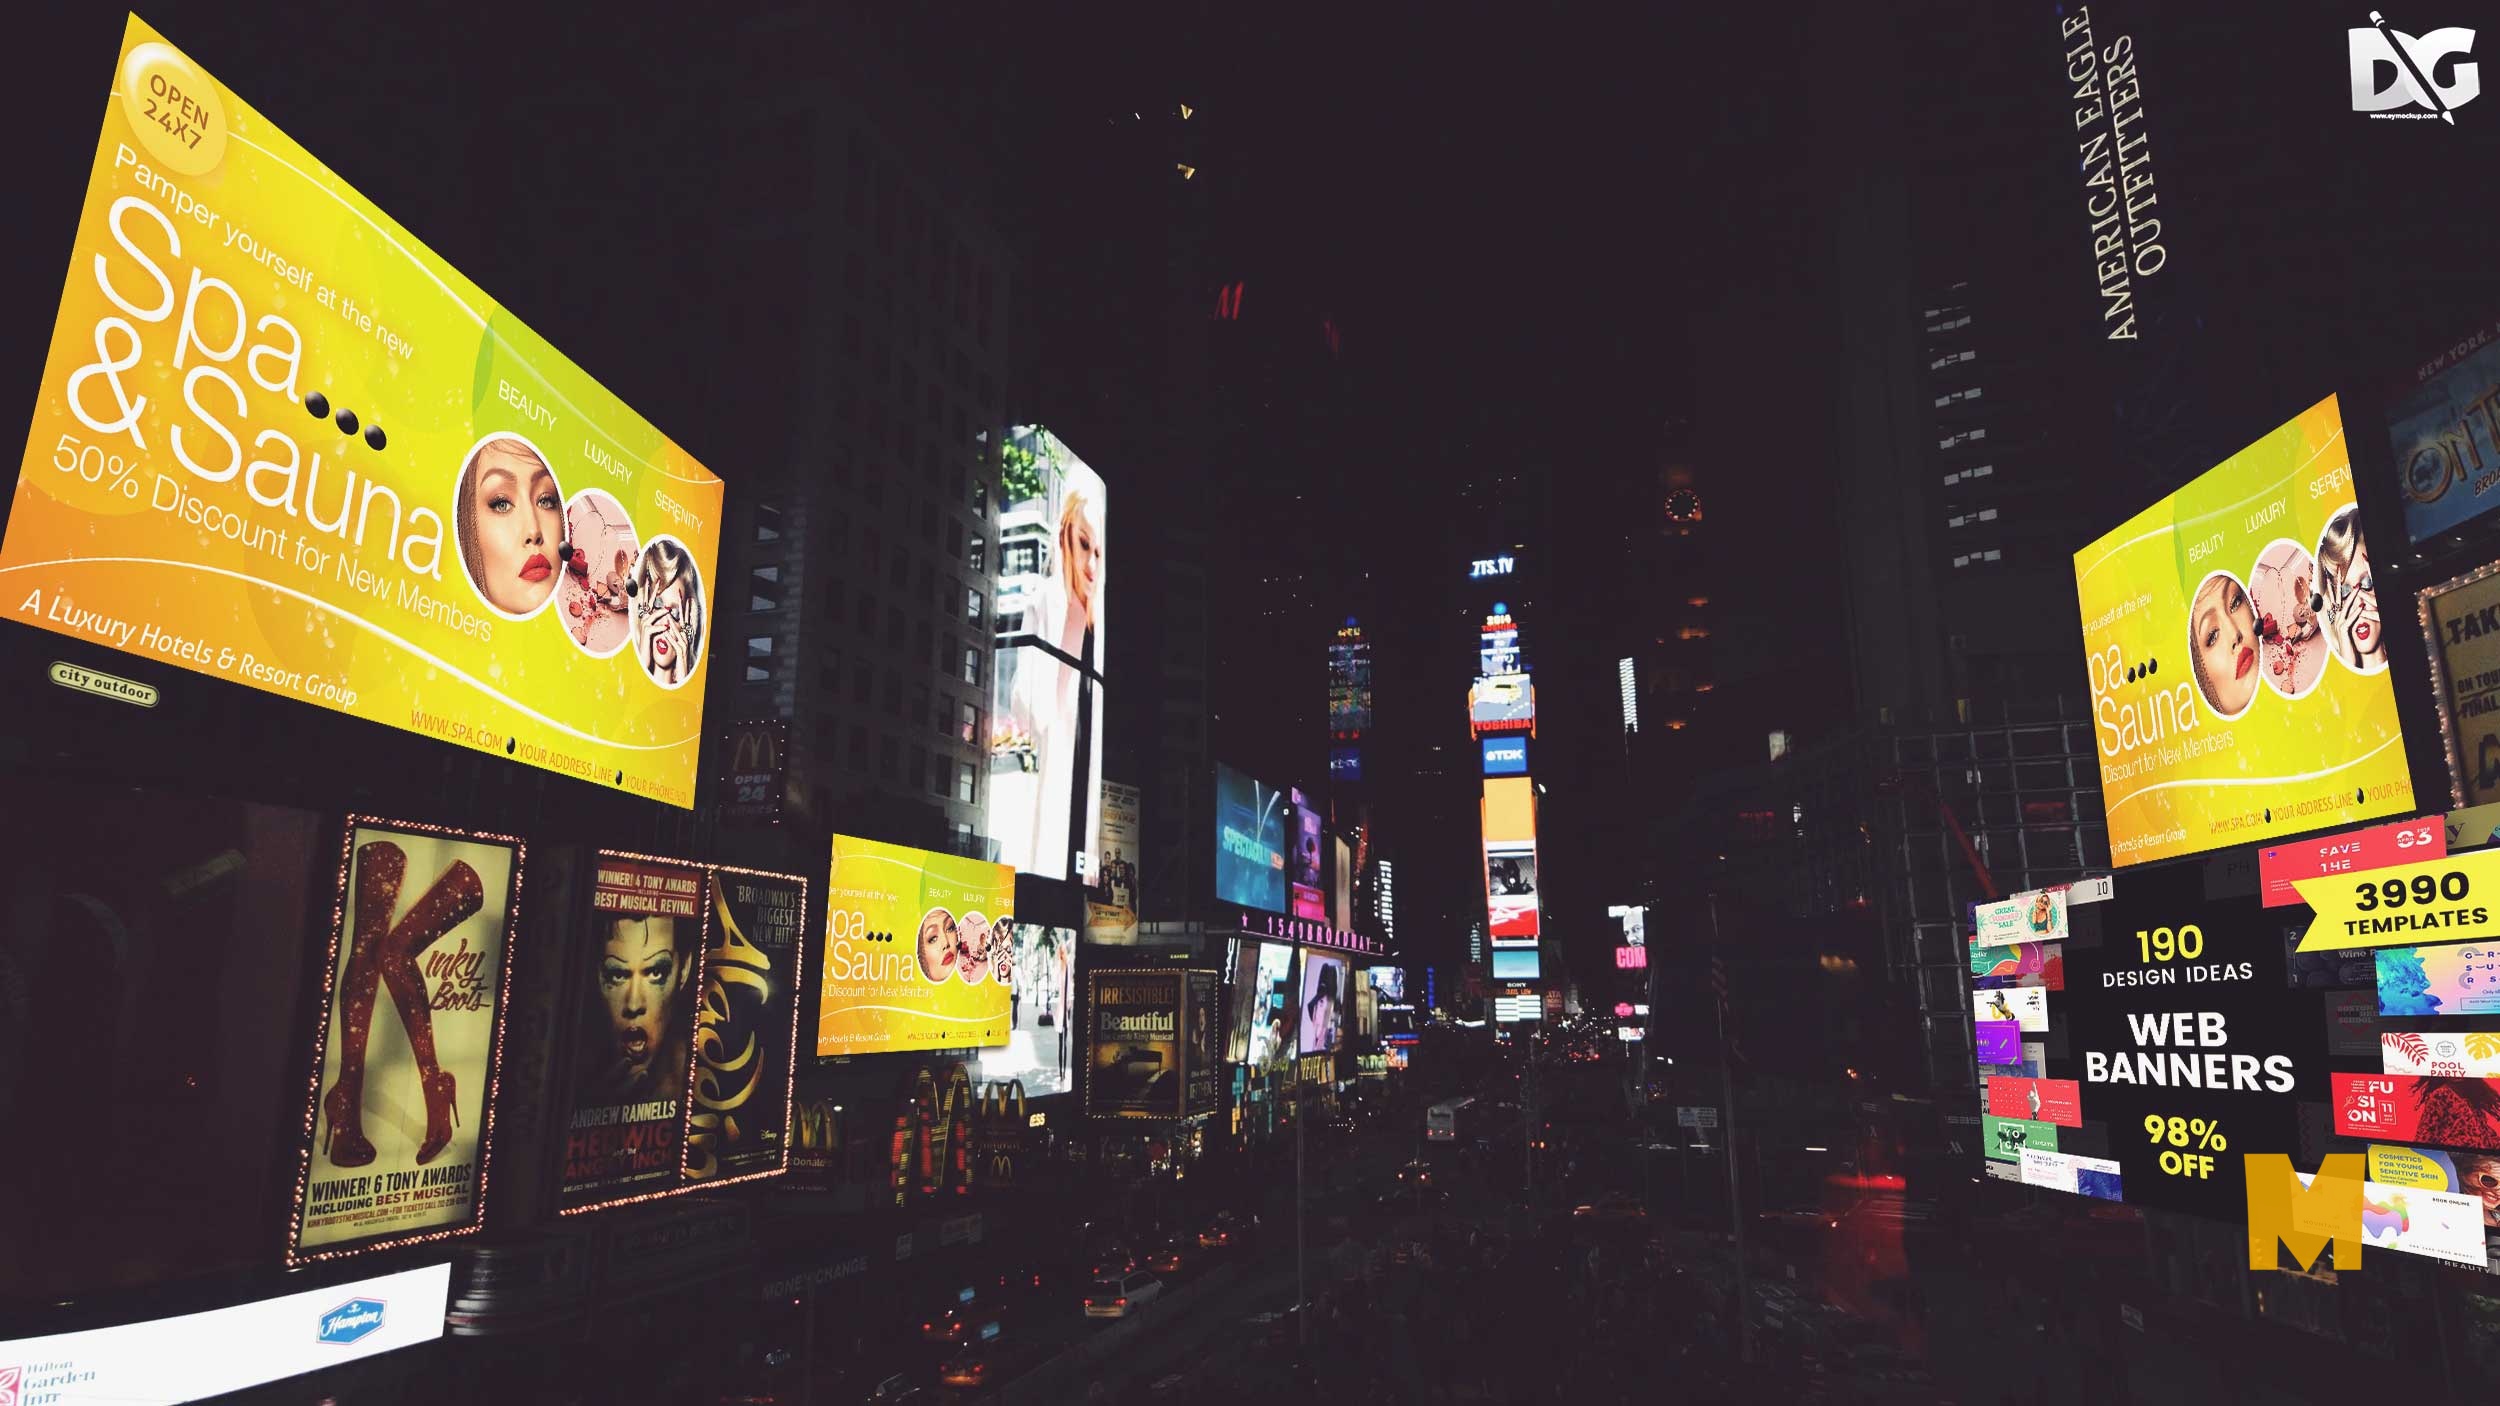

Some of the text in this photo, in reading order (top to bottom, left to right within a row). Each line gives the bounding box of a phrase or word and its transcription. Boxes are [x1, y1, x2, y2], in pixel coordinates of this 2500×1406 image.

[148, 72, 210, 131] OPEN
[143, 99, 202, 150] 24X7
[2103, 34, 2167, 277] OUTFITTERS
[2062, 5, 2138, 340] AMERICAN EAGLE
[114, 143, 414, 361] Pamper yourself at the new
[2417, 354, 2445, 382] NEW
[498, 379, 557, 431] BEAUTY
[67, 316, 444, 581] & Sauna
[584, 440, 632, 485] LUXURY
[2405, 419, 2483, 503] ON
[655, 489, 704, 536] SERENITY
[2245, 498, 2287, 535] LUXURY
[53, 434, 493, 644] 50% Discount for New Members
[2188, 531, 2225, 564] BEAUTY
[2116, 608, 2124, 620] at
[2124, 600, 2137, 616] the
[2137, 593, 2152, 610] new
[19, 588, 357, 710] A Luxury Hotels & Resort Group
[59, 667, 152, 701] city outdoor
[2457, 677, 2474, 694] ON
[2098, 681, 2200, 757] Sauna
[2459, 694, 2498, 719] FINAL
[1474, 719, 1532, 731] TOSHIBA
[411, 709, 503, 751] WWW.SPA.COM
[519, 742, 547, 765] YOUR
[549, 752, 592, 777] ADDRESS
[594, 764, 613, 783] LINE
[625, 774, 648, 793] YOUR
[2103, 755, 2142, 784] Discount
[2158, 746, 2182, 768] New
[2183, 730, 2234, 760] Members
[735, 773, 771, 785] OPEN
[2272, 804, 2295, 821] YOUR
[2296, 797, 2334, 818] ADDRESS
[2335, 792, 2353, 810] LINE
[2366, 784, 2394, 803] YOUR
[2165, 827, 2187, 846] Group
[2320, 842, 2361, 858] SAVE
[2320, 859, 2351, 873] THE
[598, 869, 633, 888] WINNER!
[643, 875, 664, 890] TONY
[665, 879, 697, 894] AWARDS
[2097, 881, 2109, 896] 10
[2355, 872, 2470, 912] 3990
[594, 891, 695, 915] BEST MUSICAL REVIVAL
[757, 906, 796, 927] BIGGEST
[753, 925, 773, 942] NEW
[2344, 907, 2489, 936] TEMPLATES
[2136, 924, 2204, 964] 190
[831, 940, 915, 982] Sauna
[2103, 962, 2253, 988] DESIGN IDEAS
[429, 981, 491, 1012] Boots
[828, 984, 866, 998] Discount
[1101, 1010, 1175, 1032] Beautiful
[2127, 1011, 2228, 1047] WEB
[1150, 1031, 1175, 1041] Musical
[2086, 1051, 2295, 1093] BANNERS
[2430, 1070, 2467, 1078] PARTY
[2431, 1061, 2465, 1070] POOL
[2357, 1095, 2375, 1108] SI
[2368, 1080, 2394, 1094] FU
[570, 1099, 678, 1130] ANDREW RANNELLS
[2347, 1109, 2377, 1123] ON
[2381, 1103, 2393, 1113] 11
[2144, 1114, 2227, 1152] 98%
[2159, 1150, 2214, 1180] OFF
[2378, 1153, 2422, 1163] COSMETICS
[2396, 1163, 2423, 1171] YOUNG
[311, 1163, 472, 1203] WINNER! 6 TONY AWARDS
[2379, 1168, 2438, 1181] SENSITIVE SKIN
[309, 1183, 469, 1217] INCLUDING BEST MUSICAL
[321, 1309, 383, 1337] Hampton
[23, 1369, 97, 1392] Garden
